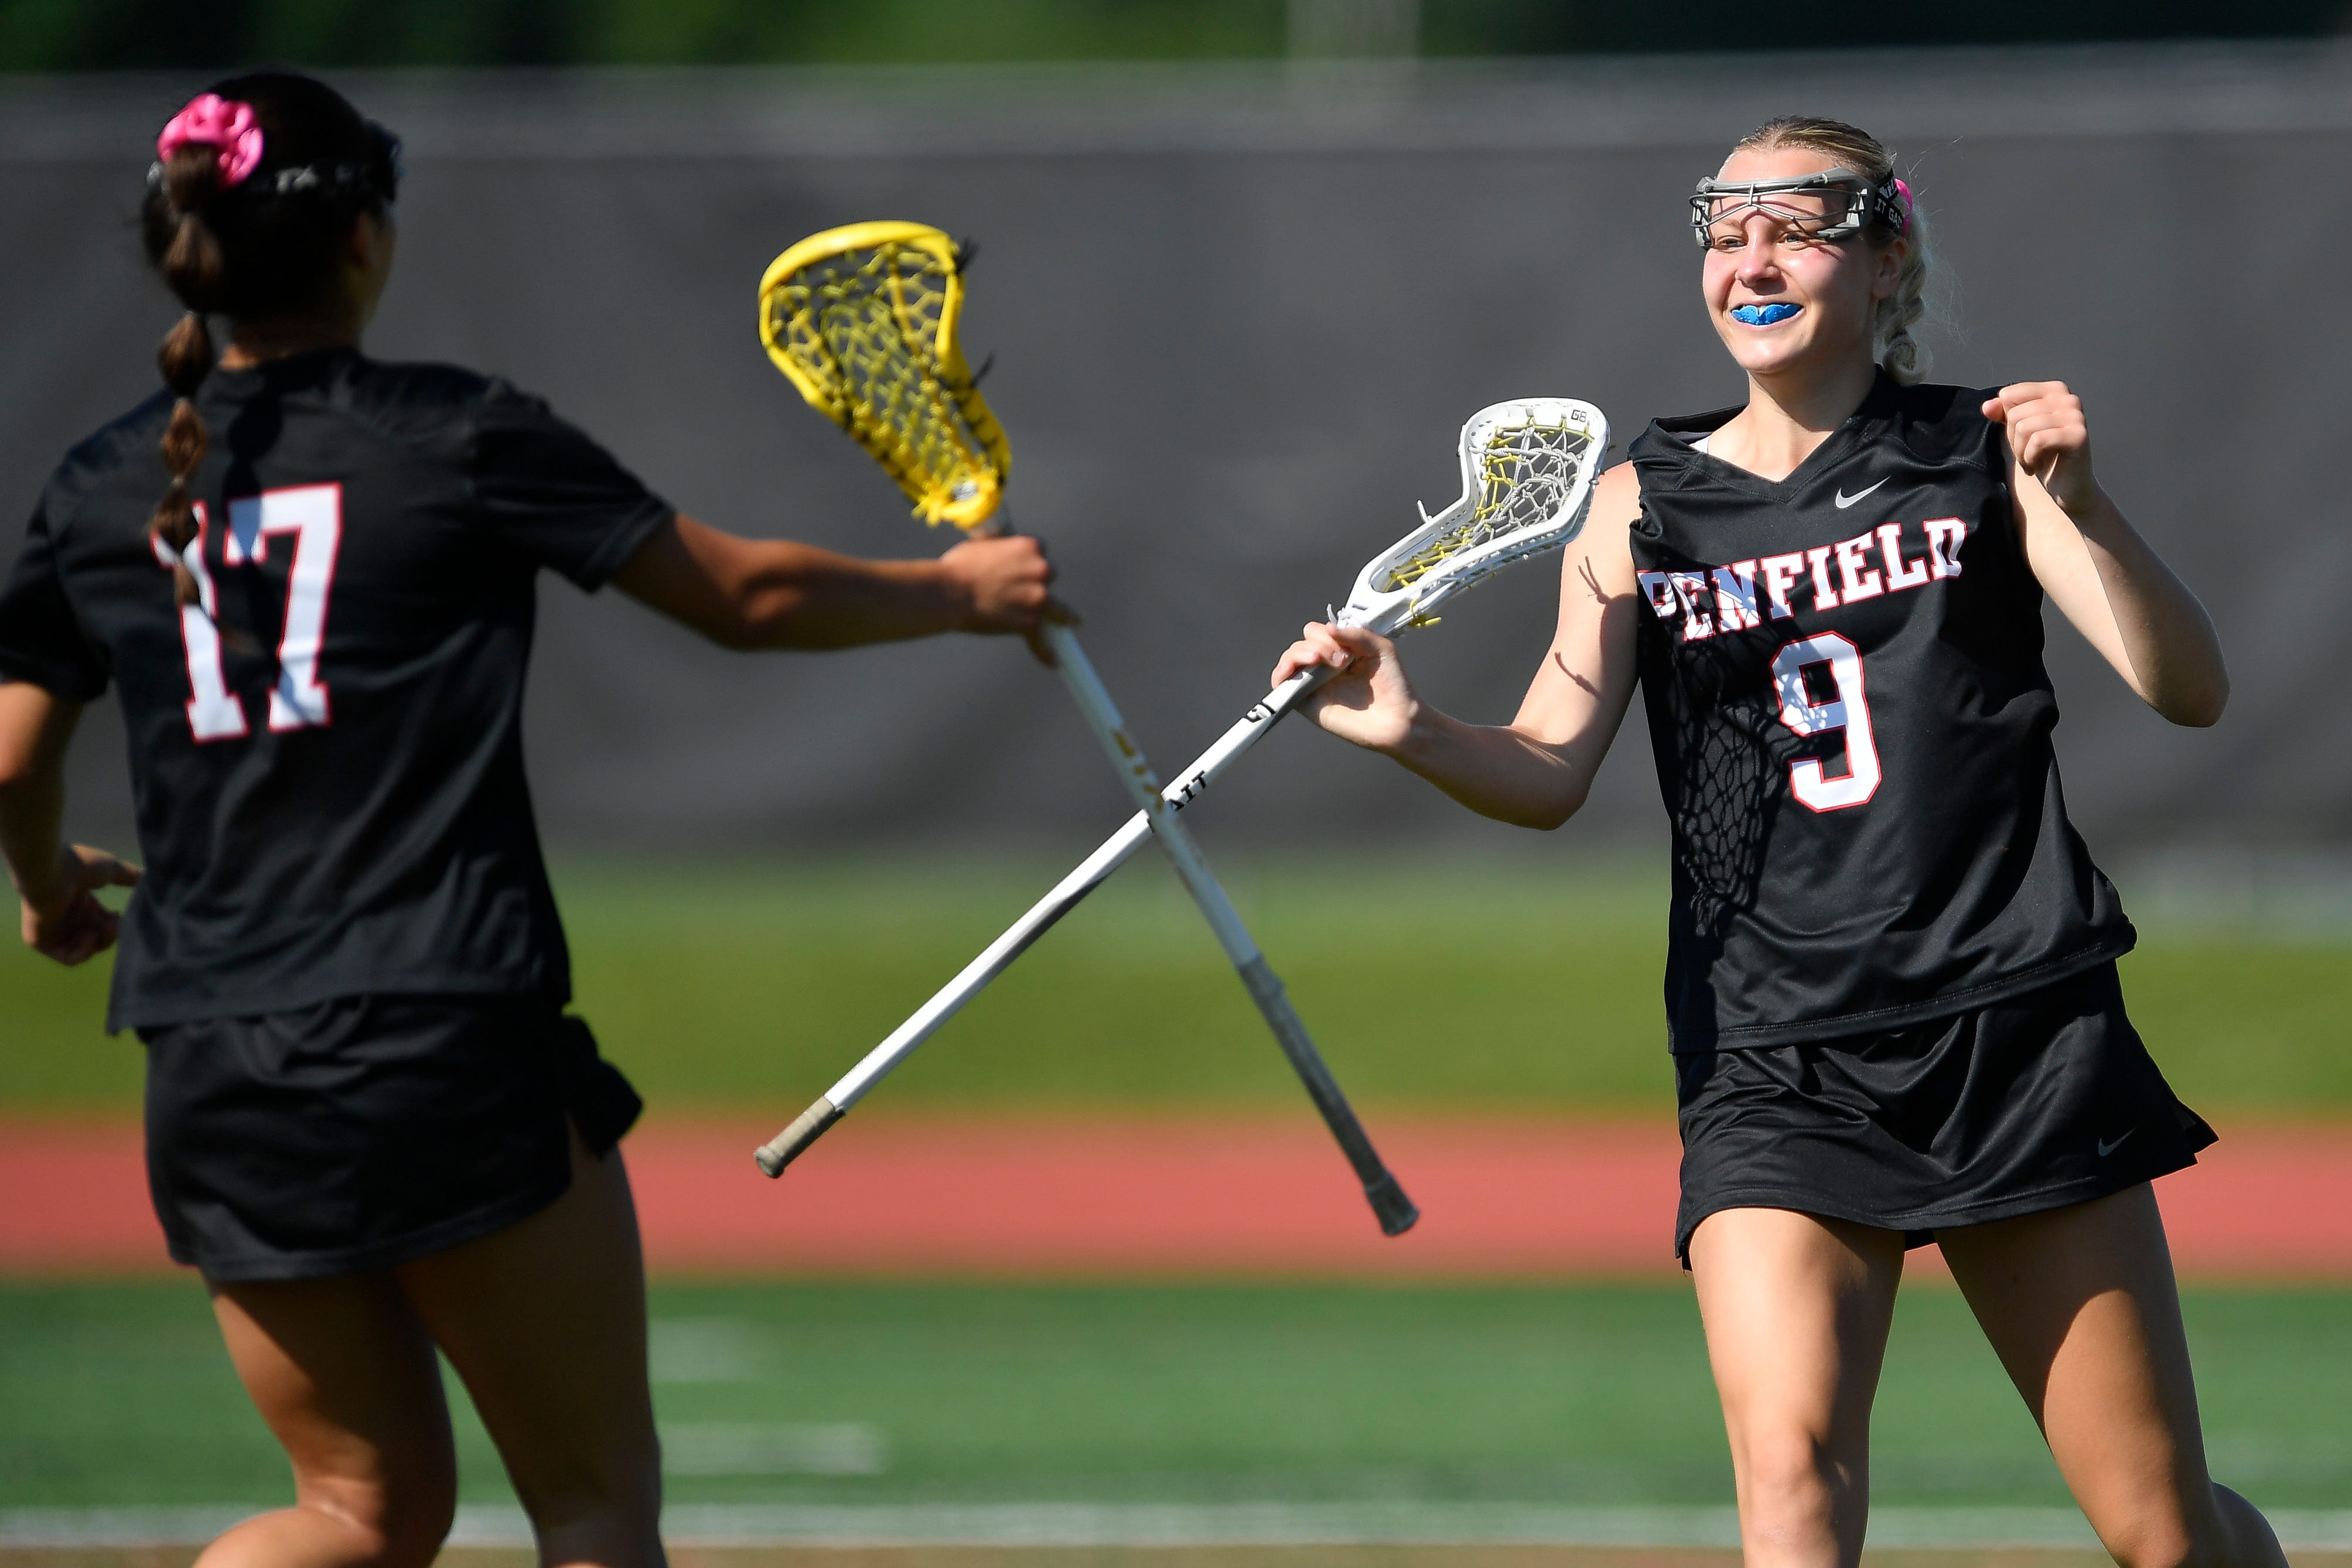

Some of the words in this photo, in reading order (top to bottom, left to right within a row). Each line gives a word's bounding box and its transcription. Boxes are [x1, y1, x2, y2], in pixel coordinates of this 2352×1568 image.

[149, 481, 344, 744] 17
[1636, 517, 1967, 641] PENFIELD
[1169, 770, 1206, 811] AIT
[1770, 630, 1883, 813] 9
